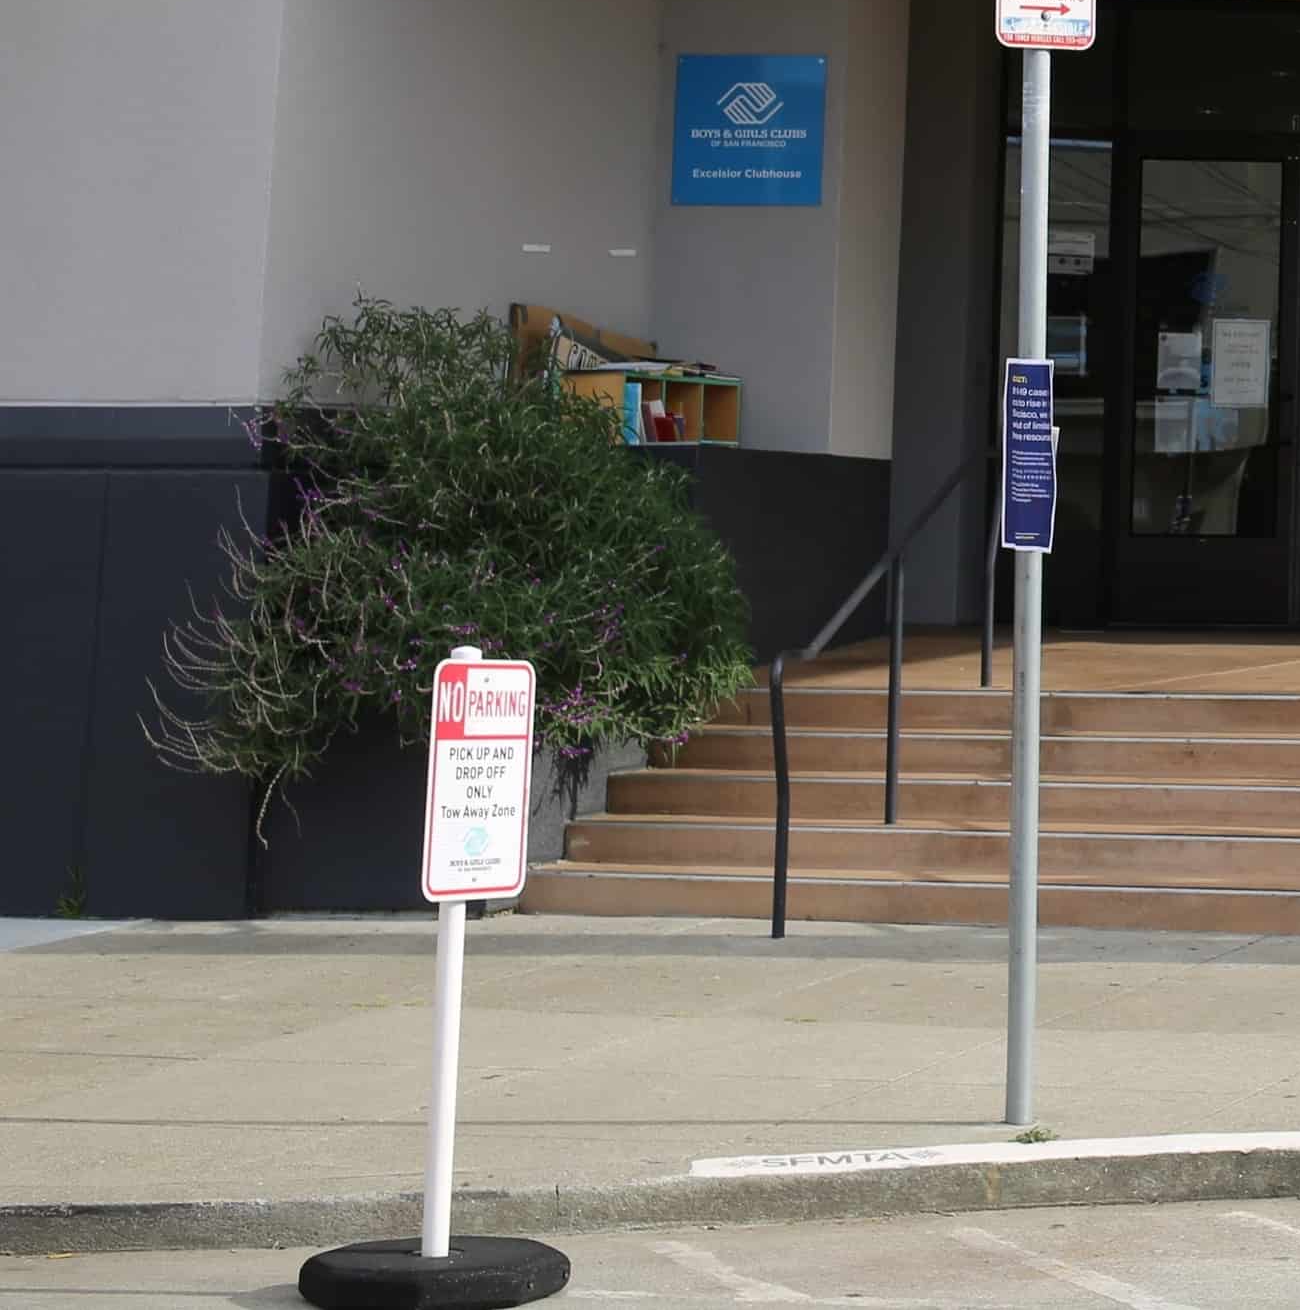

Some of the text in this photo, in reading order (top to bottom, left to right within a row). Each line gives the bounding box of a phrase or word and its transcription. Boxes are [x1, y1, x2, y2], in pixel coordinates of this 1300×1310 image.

[691, 130, 807, 139] BOYS & GIRLS CLUBS
[692, 169, 802, 178] Excelsior Clubhouse
[439, 680, 526, 722] NO PARKING
[449, 747, 514, 760] PICK UP AND
[456, 766, 506, 780] DROP OFF
[466, 786, 493, 799] ONLY
[441, 804, 516, 820] Tow Away Zone
[760, 1152, 911, 1167] SFMTA
